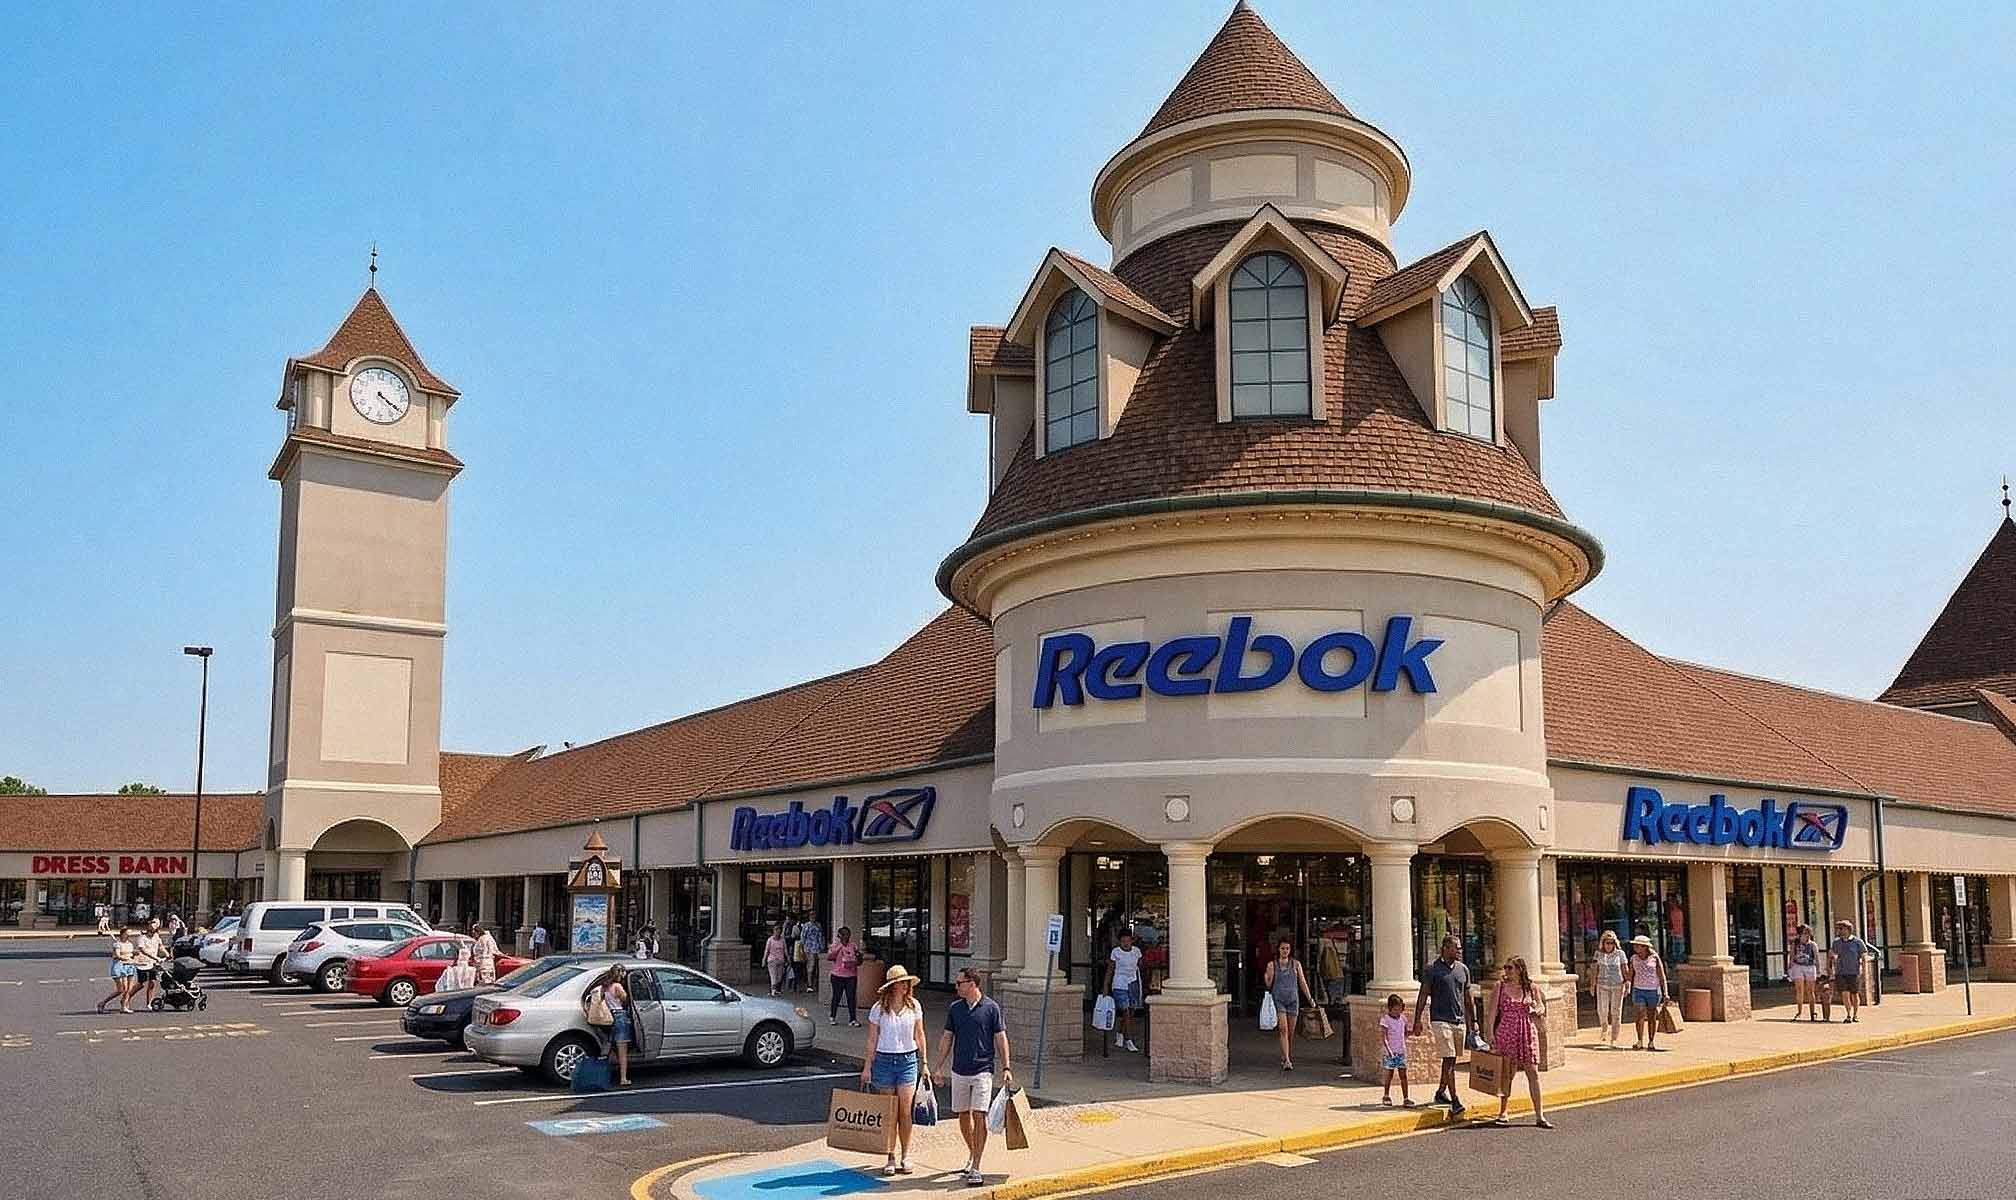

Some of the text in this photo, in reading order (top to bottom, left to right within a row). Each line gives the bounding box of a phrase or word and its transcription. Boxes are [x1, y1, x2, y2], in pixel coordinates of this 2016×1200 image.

[1033, 616, 1446, 709] Reebok
[730, 796, 859, 850] Reebok
[1623, 786, 1789, 848] Reebok
[32, 855, 188, 874] DRESS BARN
[835, 1107, 882, 1127] Outlet
